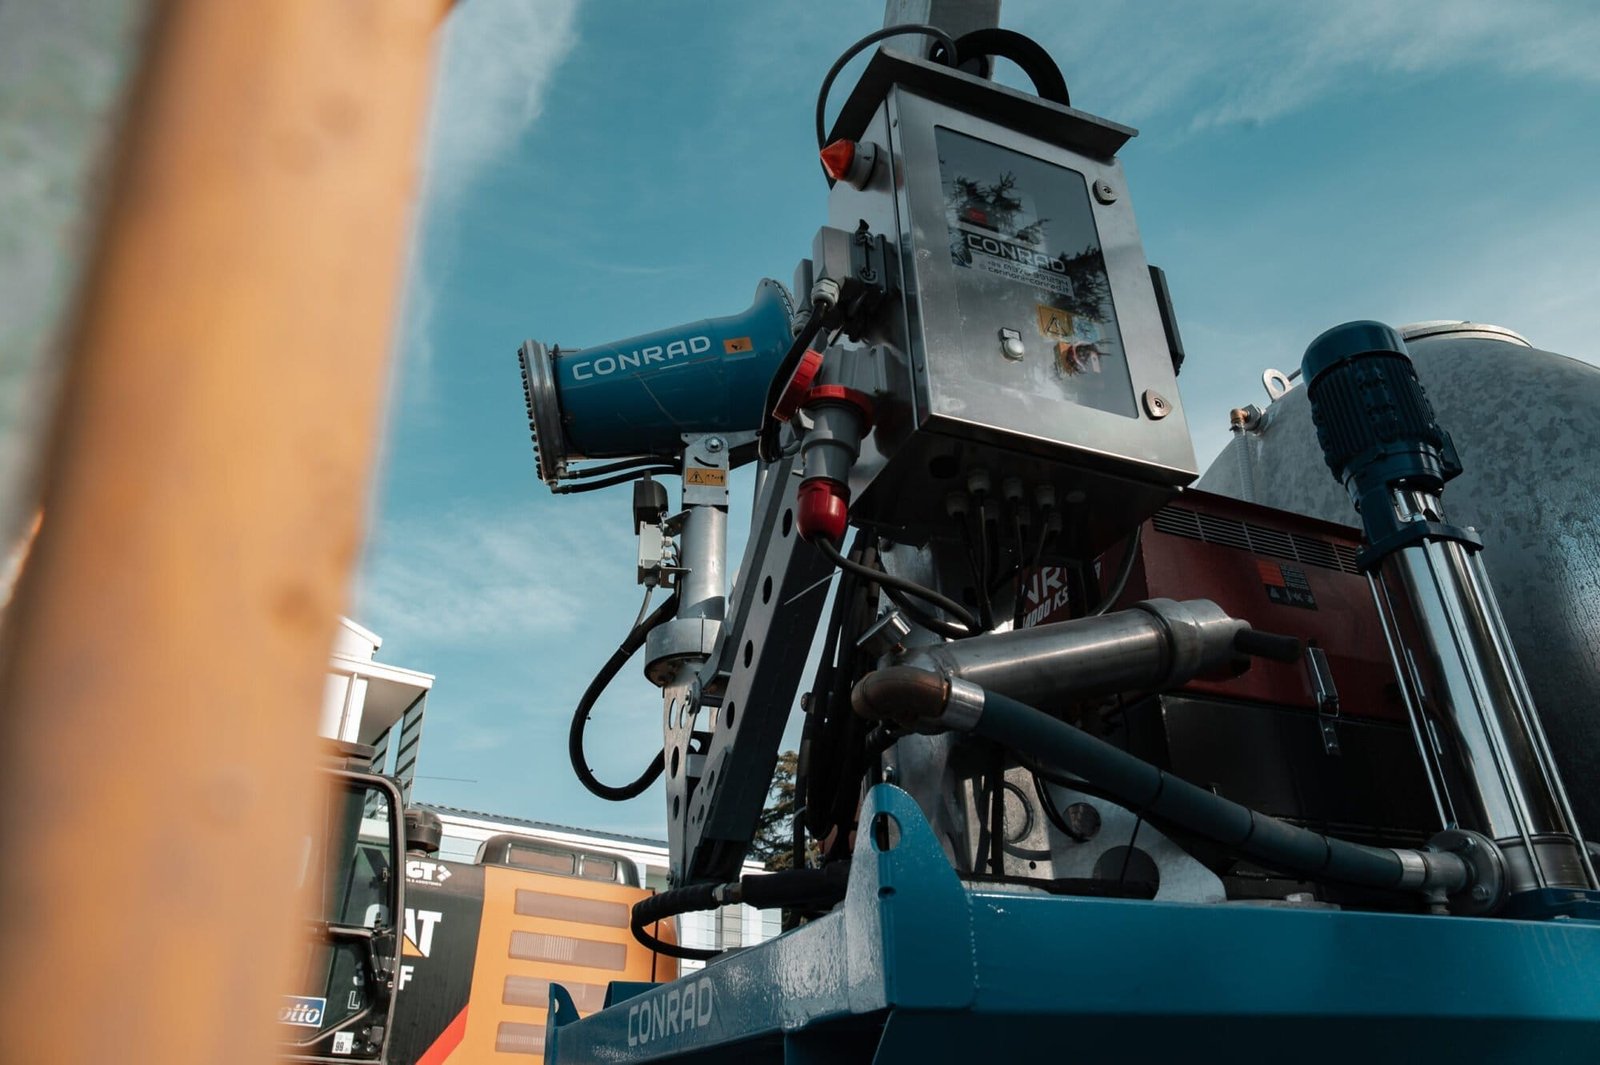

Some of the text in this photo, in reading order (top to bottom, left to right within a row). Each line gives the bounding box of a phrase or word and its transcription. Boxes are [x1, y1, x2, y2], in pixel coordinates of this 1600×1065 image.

[967, 234, 1066, 273] CONRAD
[572, 336, 711, 381] CONRAD
[405, 859, 437, 881] GT
[627, 976, 713, 1047] CONRAD
